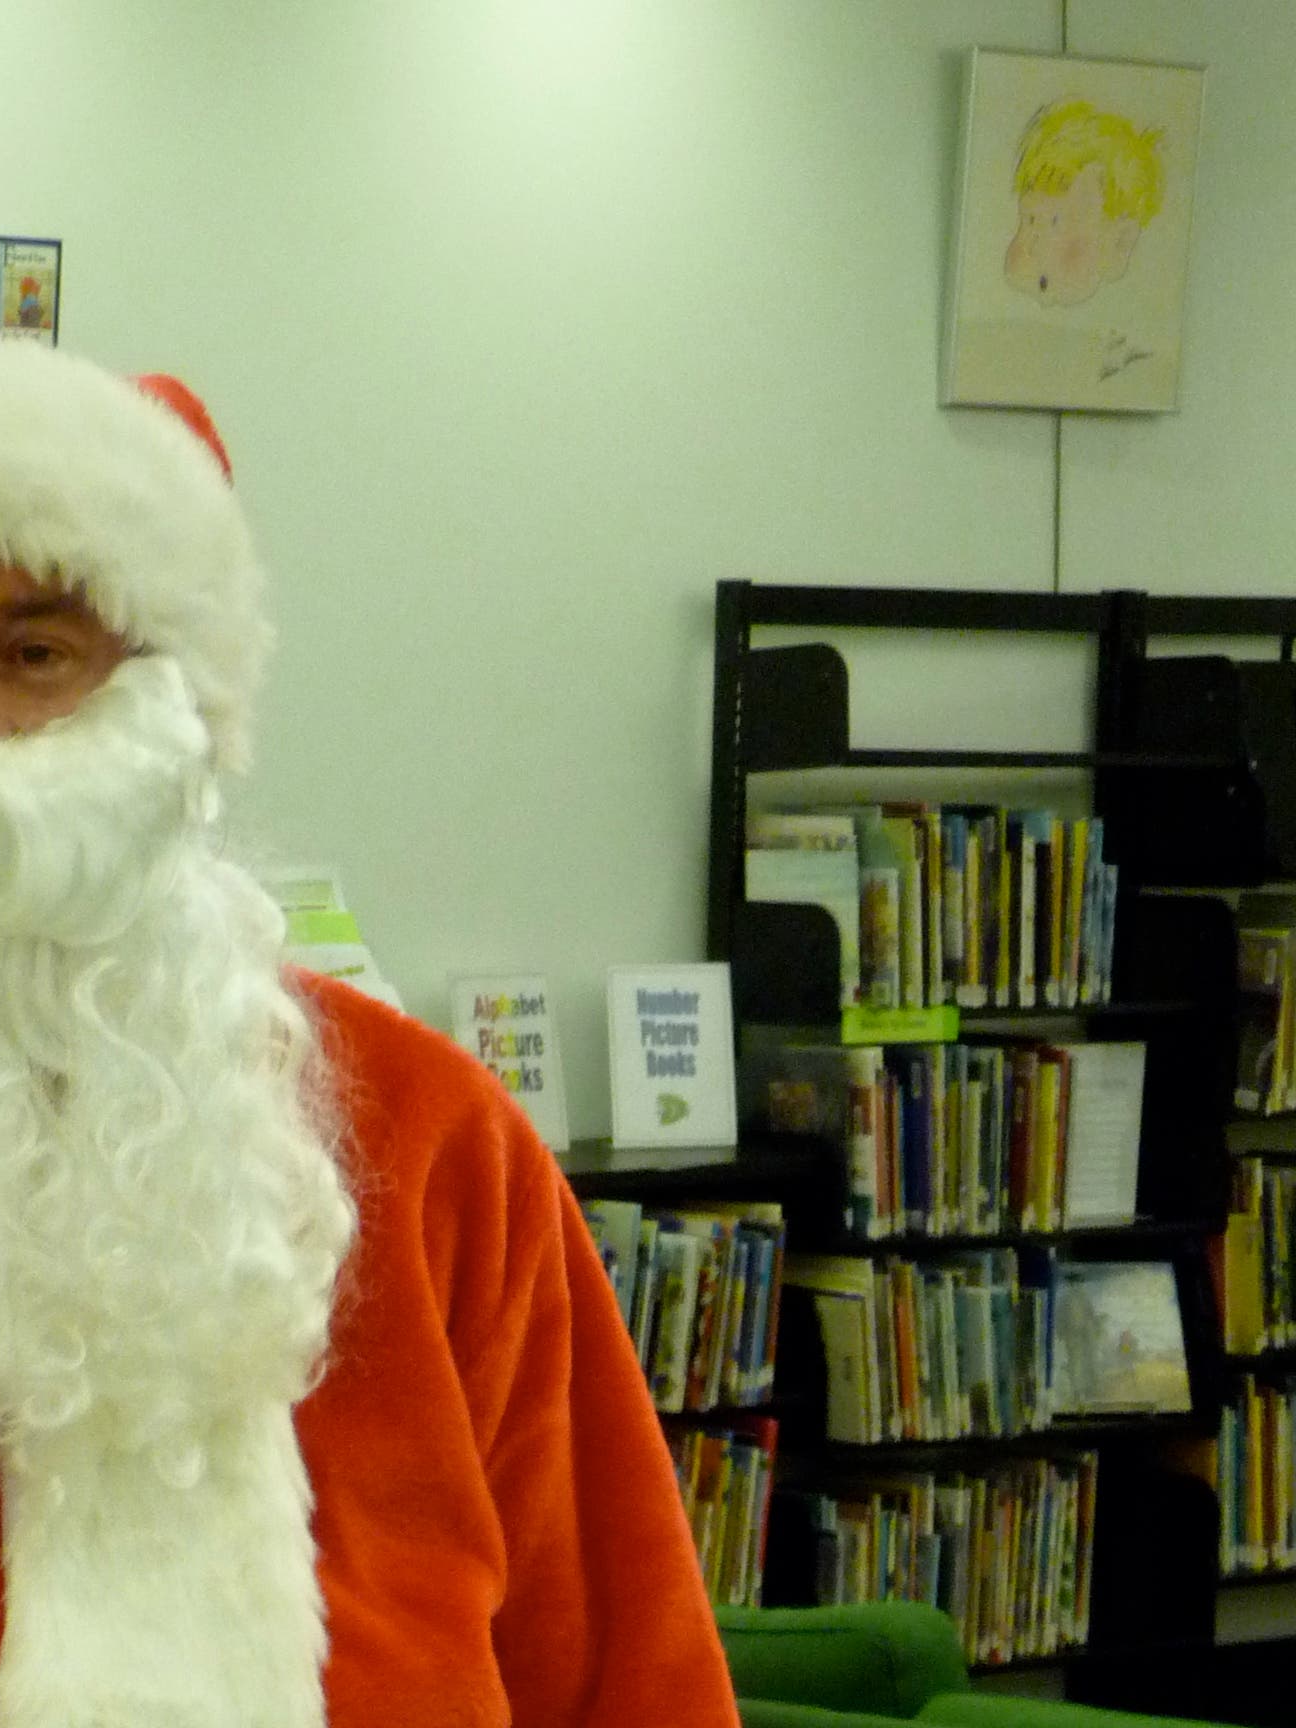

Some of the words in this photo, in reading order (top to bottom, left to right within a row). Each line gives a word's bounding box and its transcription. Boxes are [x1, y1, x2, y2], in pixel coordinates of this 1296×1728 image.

[473, 992, 546, 1022] Alphabet
[636, 988, 700, 1016] Number
[478, 1028, 544, 1059] Picture
[640, 1020, 700, 1048] Picture
[487, 1062, 544, 1093] ooks
[646, 1050, 696, 1079] Books
